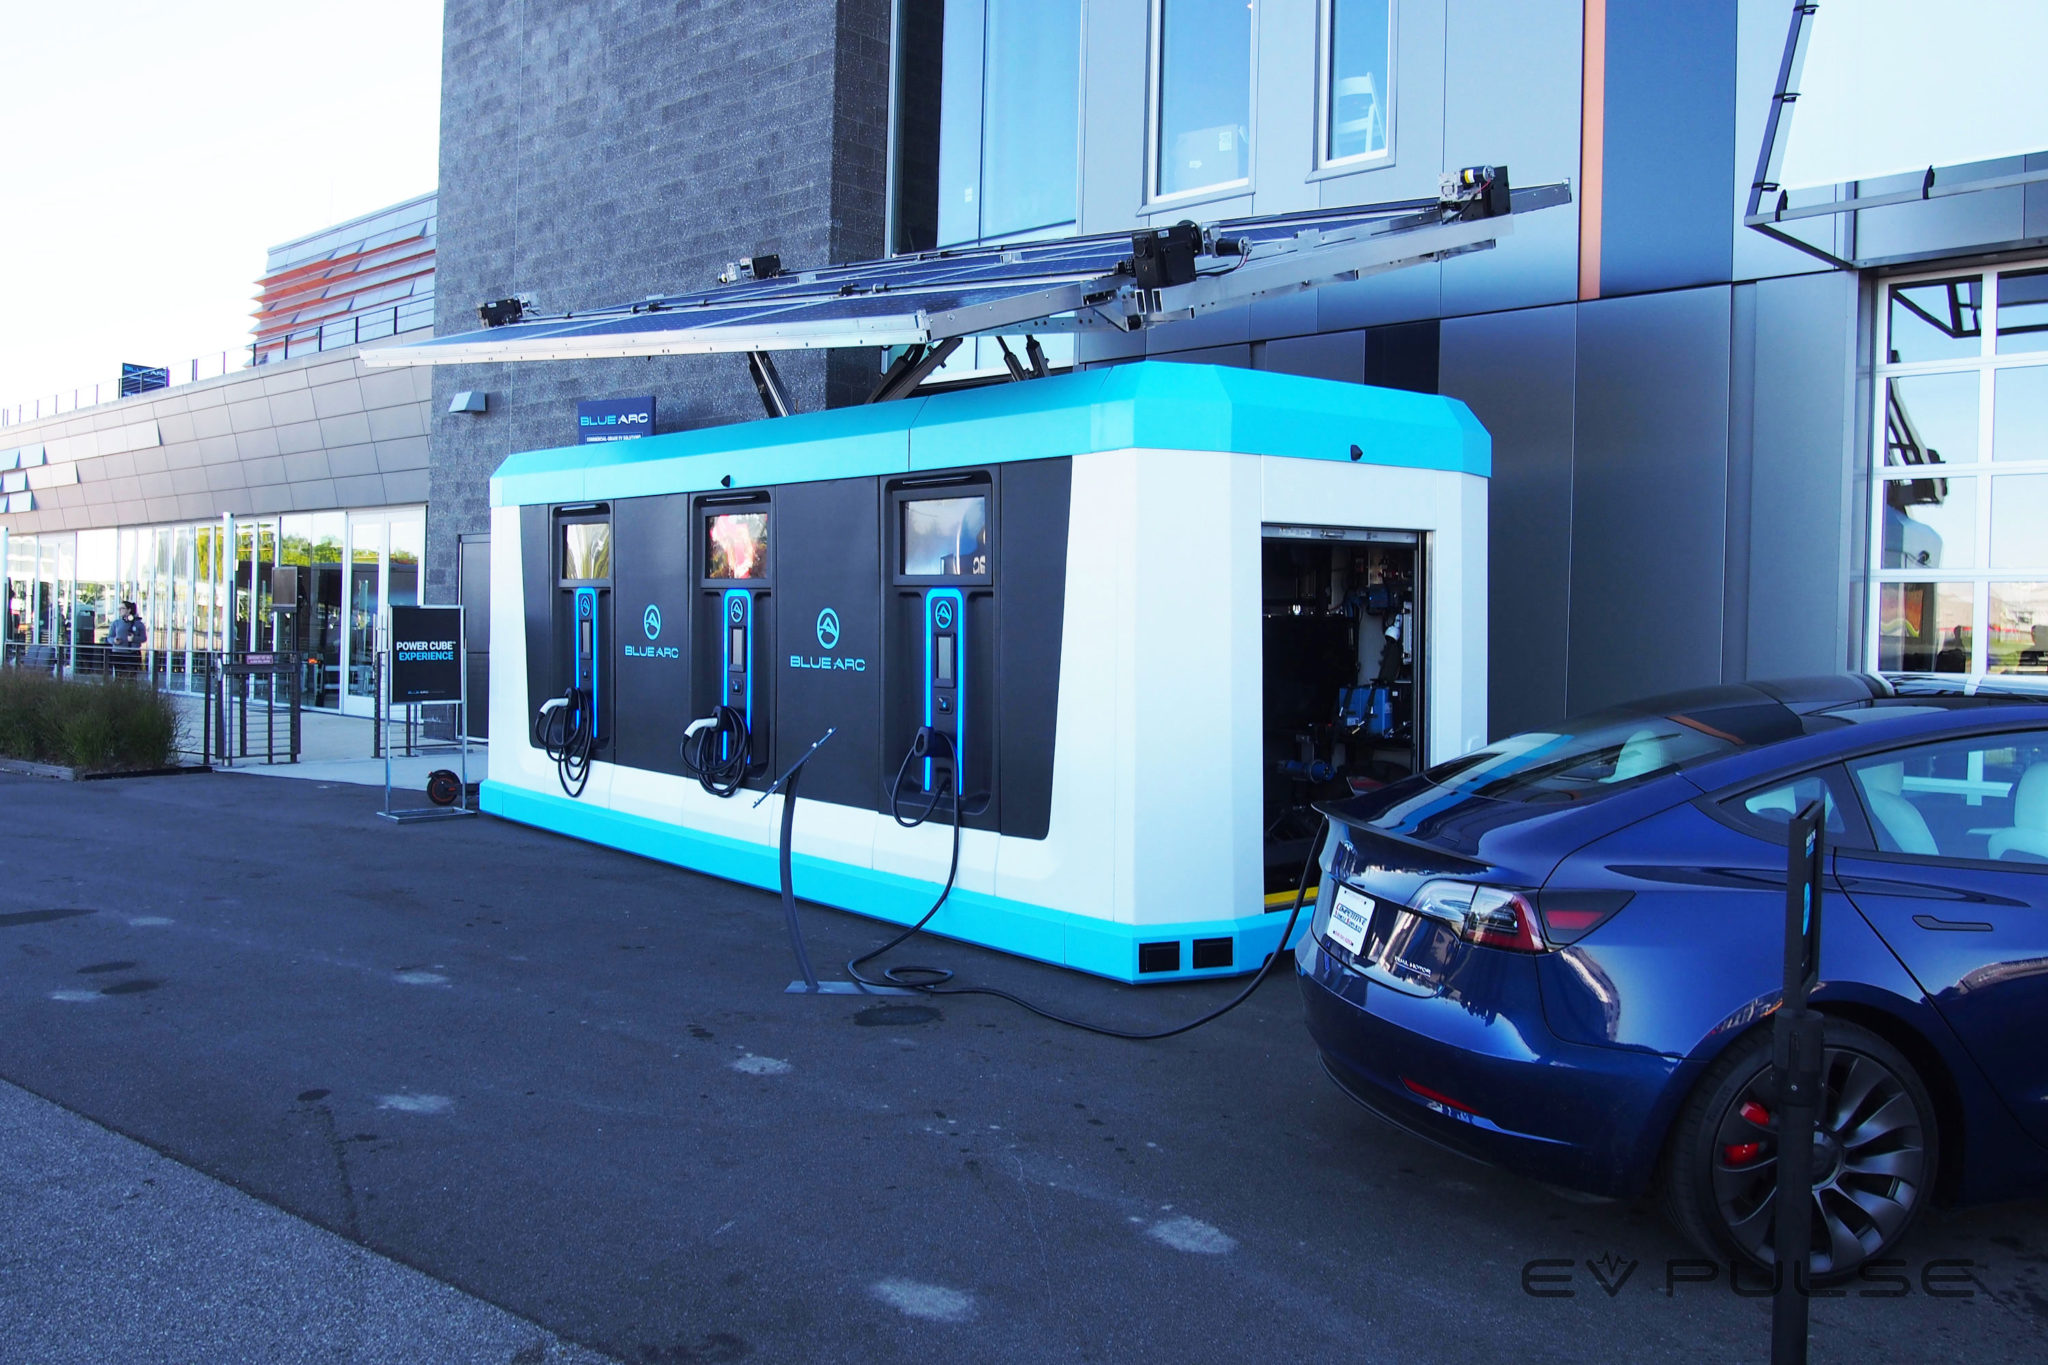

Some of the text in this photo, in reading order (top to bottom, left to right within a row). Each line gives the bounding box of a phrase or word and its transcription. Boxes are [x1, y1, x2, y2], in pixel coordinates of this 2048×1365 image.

[580, 413, 648, 426] BLUE ARC
[396, 641, 428, 651] POWER
[625, 645, 679, 659] BLUE ARC
[399, 651, 454, 661] EXPERIENCE
[789, 655, 866, 672] BLUE ARC
